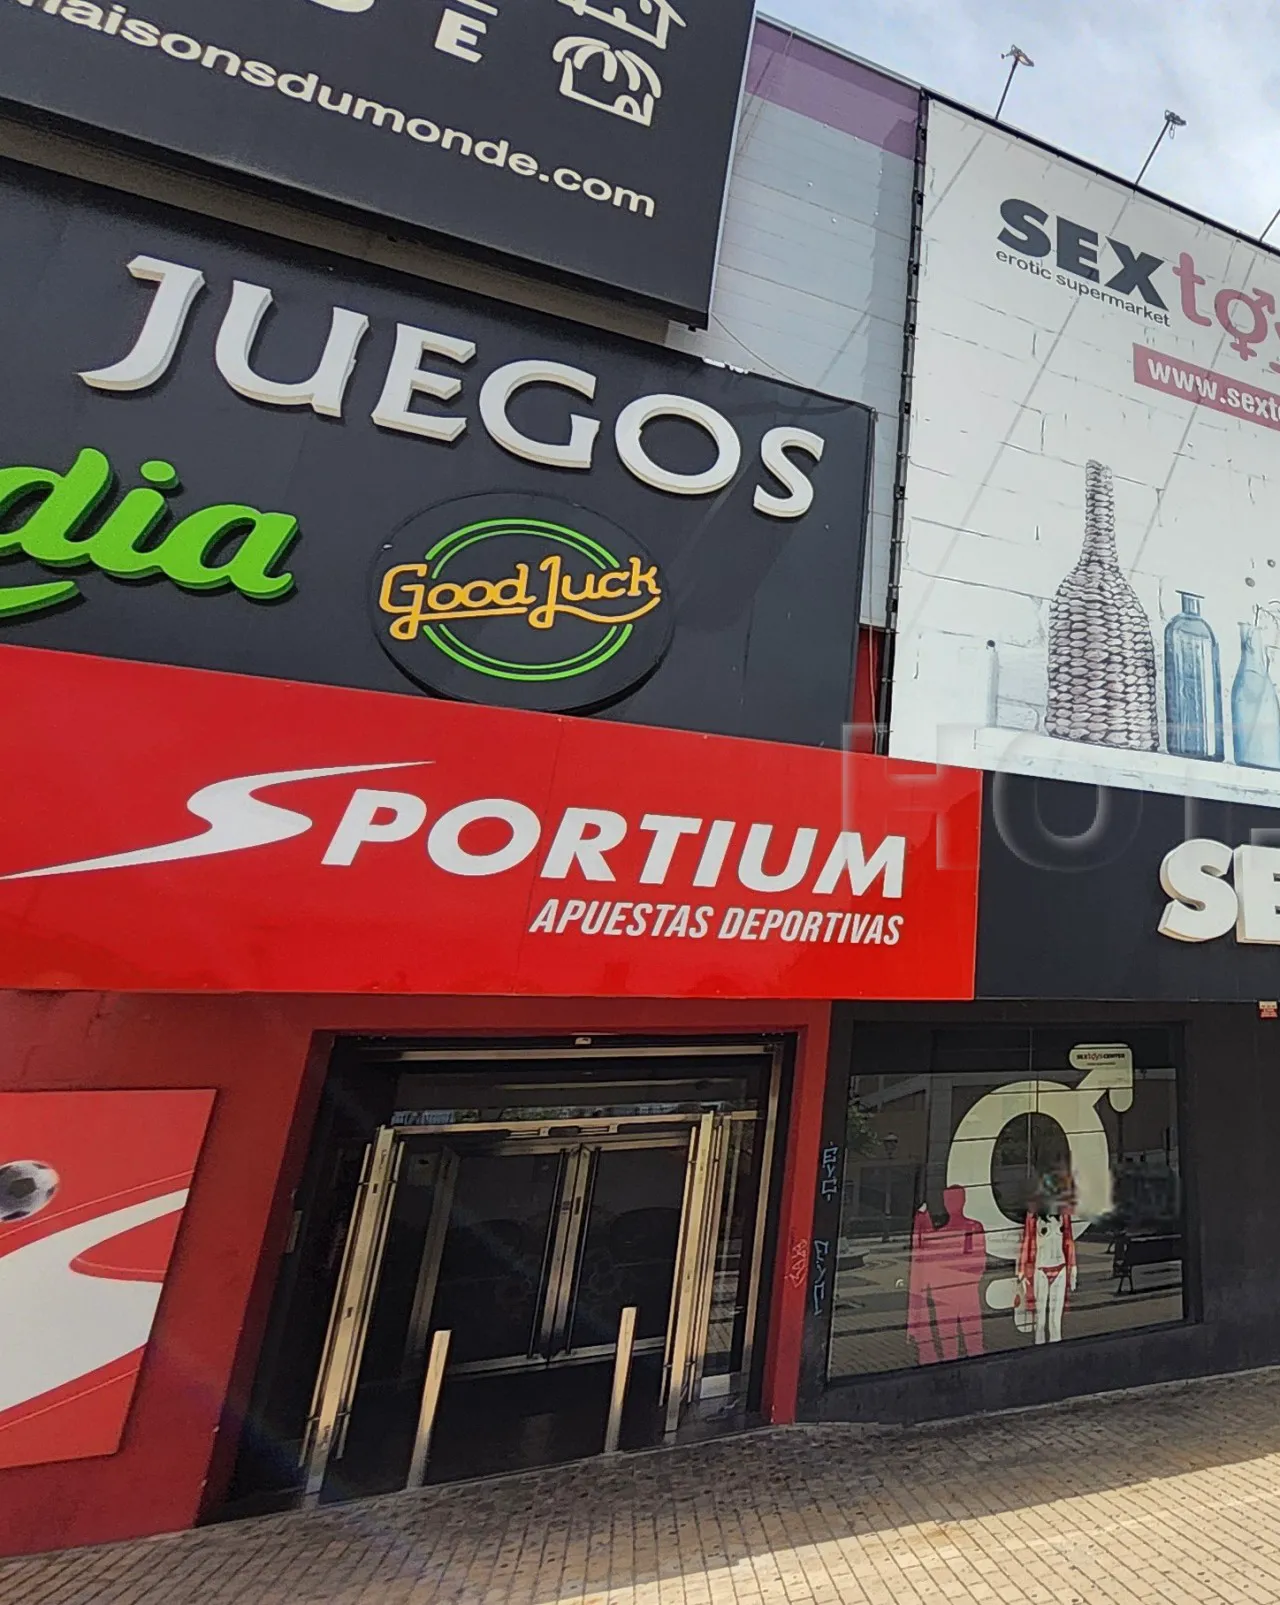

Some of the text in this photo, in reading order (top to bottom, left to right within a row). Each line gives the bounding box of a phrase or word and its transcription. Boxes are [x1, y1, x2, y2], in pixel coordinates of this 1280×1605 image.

[995, 250, 1171, 328] erotic supermarket
[76, 255, 824, 519] JUEGOS
[378, 555, 662, 640] Good Luck
[0, 760, 907, 899] SPORTIUM
[528, 898, 904, 946] APUESTAS DEPORTIVAS
